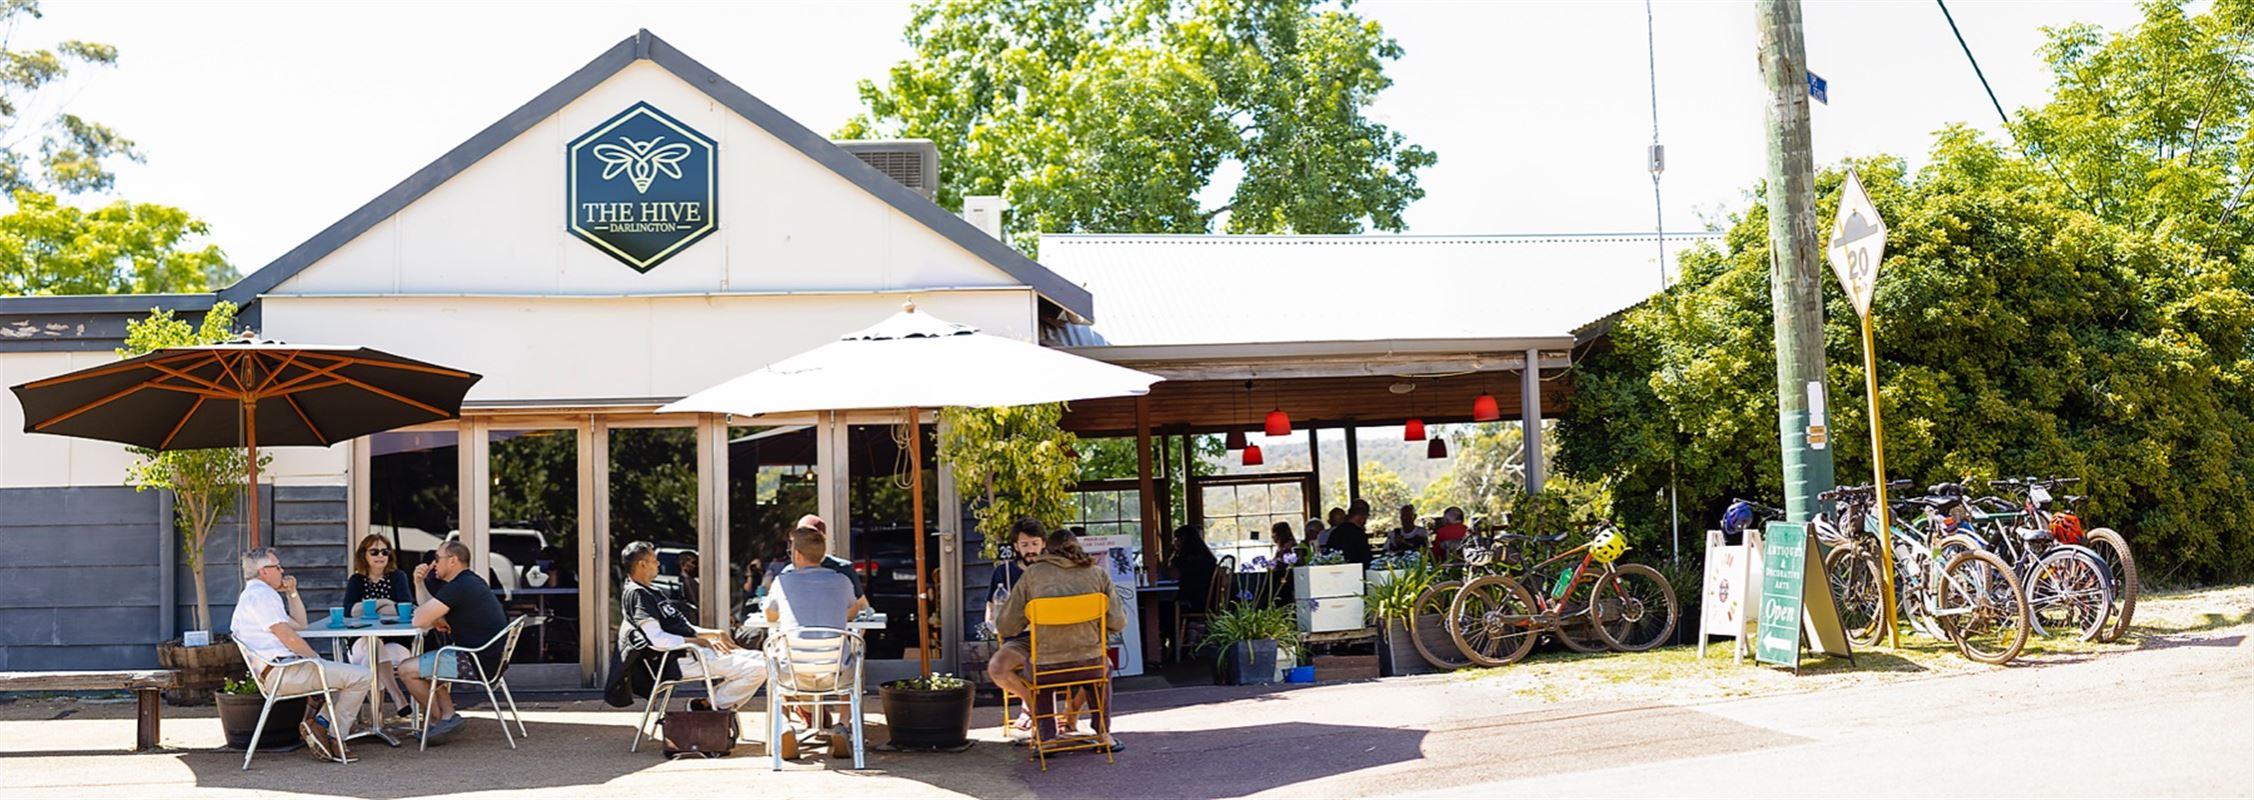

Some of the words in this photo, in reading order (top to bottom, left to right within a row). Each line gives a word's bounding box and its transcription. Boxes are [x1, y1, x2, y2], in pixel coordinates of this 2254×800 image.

[582, 202, 634, 223] THE
[640, 202, 702, 222] HIVE
[610, 223, 676, 233] DARLINGTON
[1848, 247, 1869, 280] 20
[999, 545, 1013, 559] 26
[1766, 598, 1795, 625] Open
